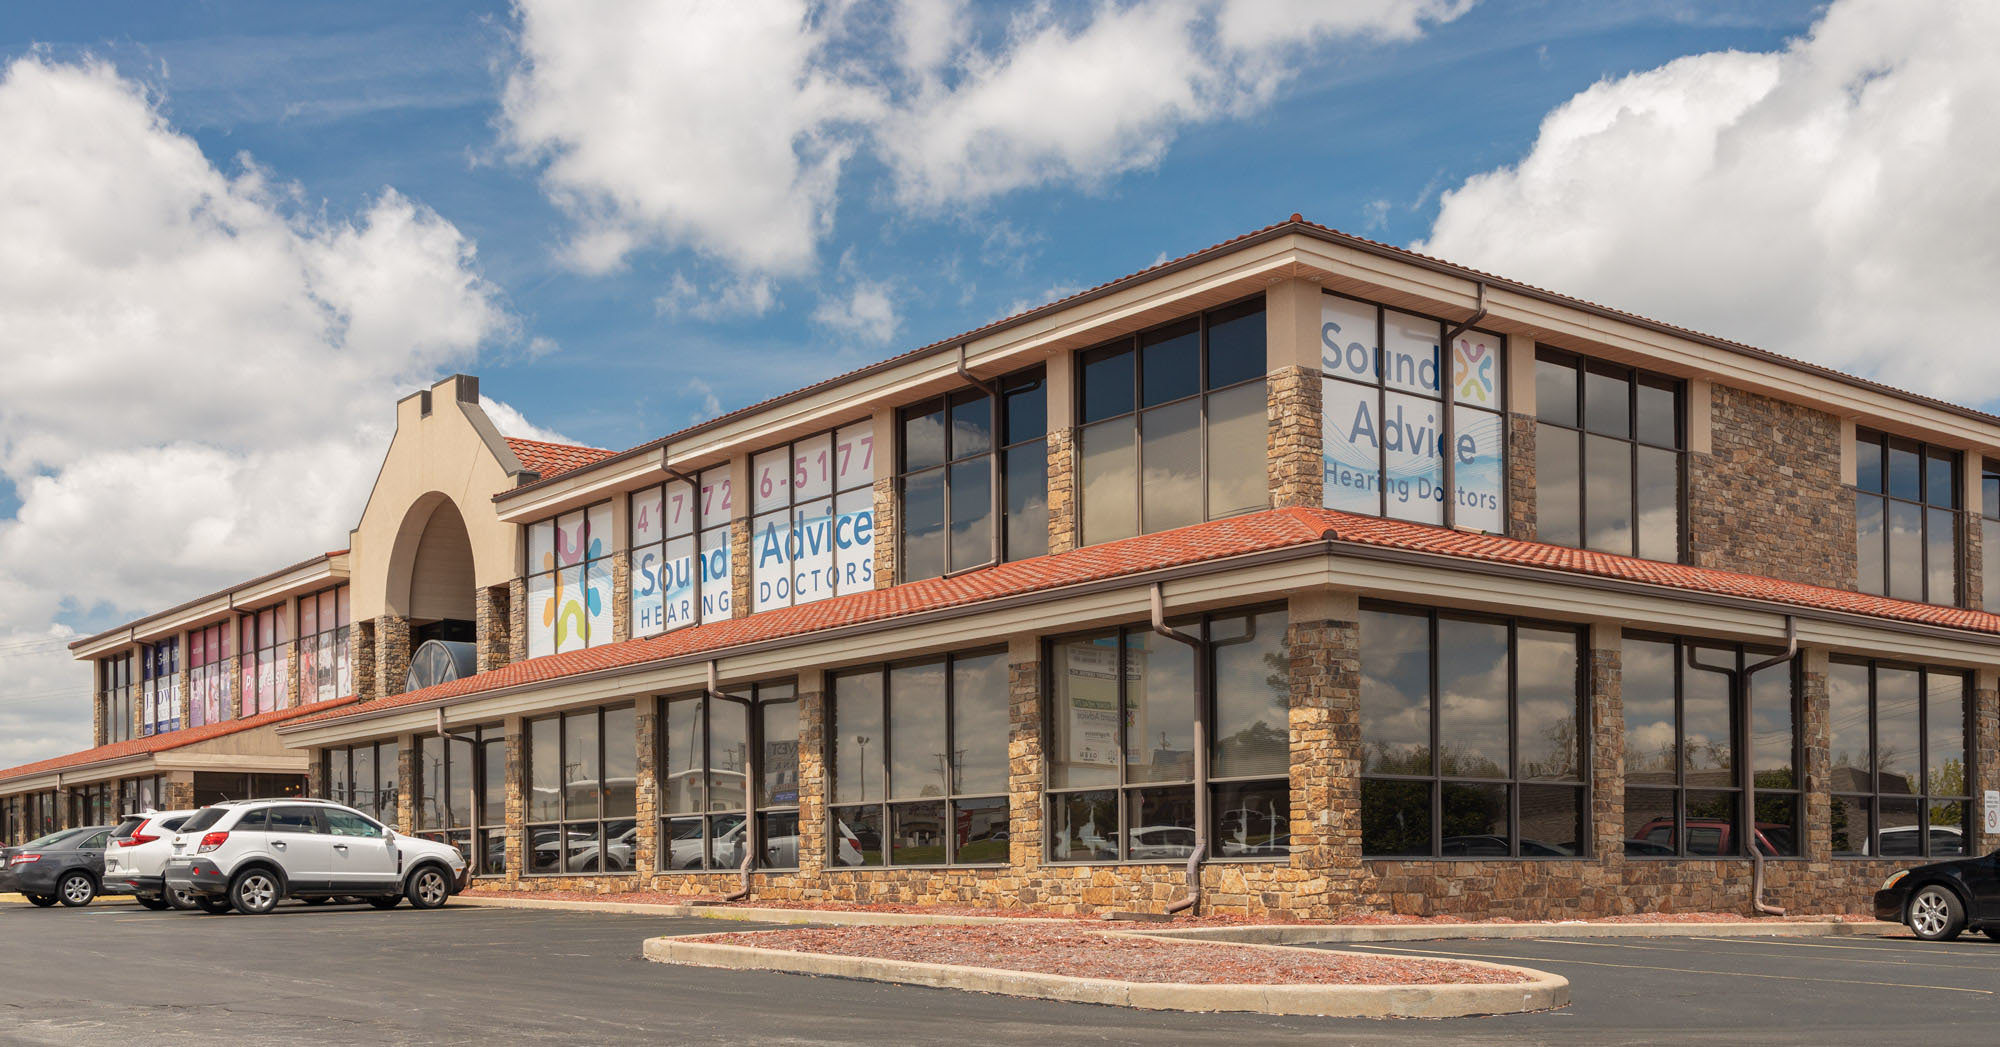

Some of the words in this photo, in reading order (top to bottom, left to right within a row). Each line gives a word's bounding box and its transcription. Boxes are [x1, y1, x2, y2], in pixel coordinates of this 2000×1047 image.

[1322, 322, 1440, 391] Sound
[1323, 460, 1410, 503] Hearing
[1418, 477, 1498, 511] Dotors
[641, 531, 727, 597] Sound
[759, 505, 873, 569] Advice
[641, 590, 729, 629] HEARNG
[760, 558, 872, 603] DOCTORS
